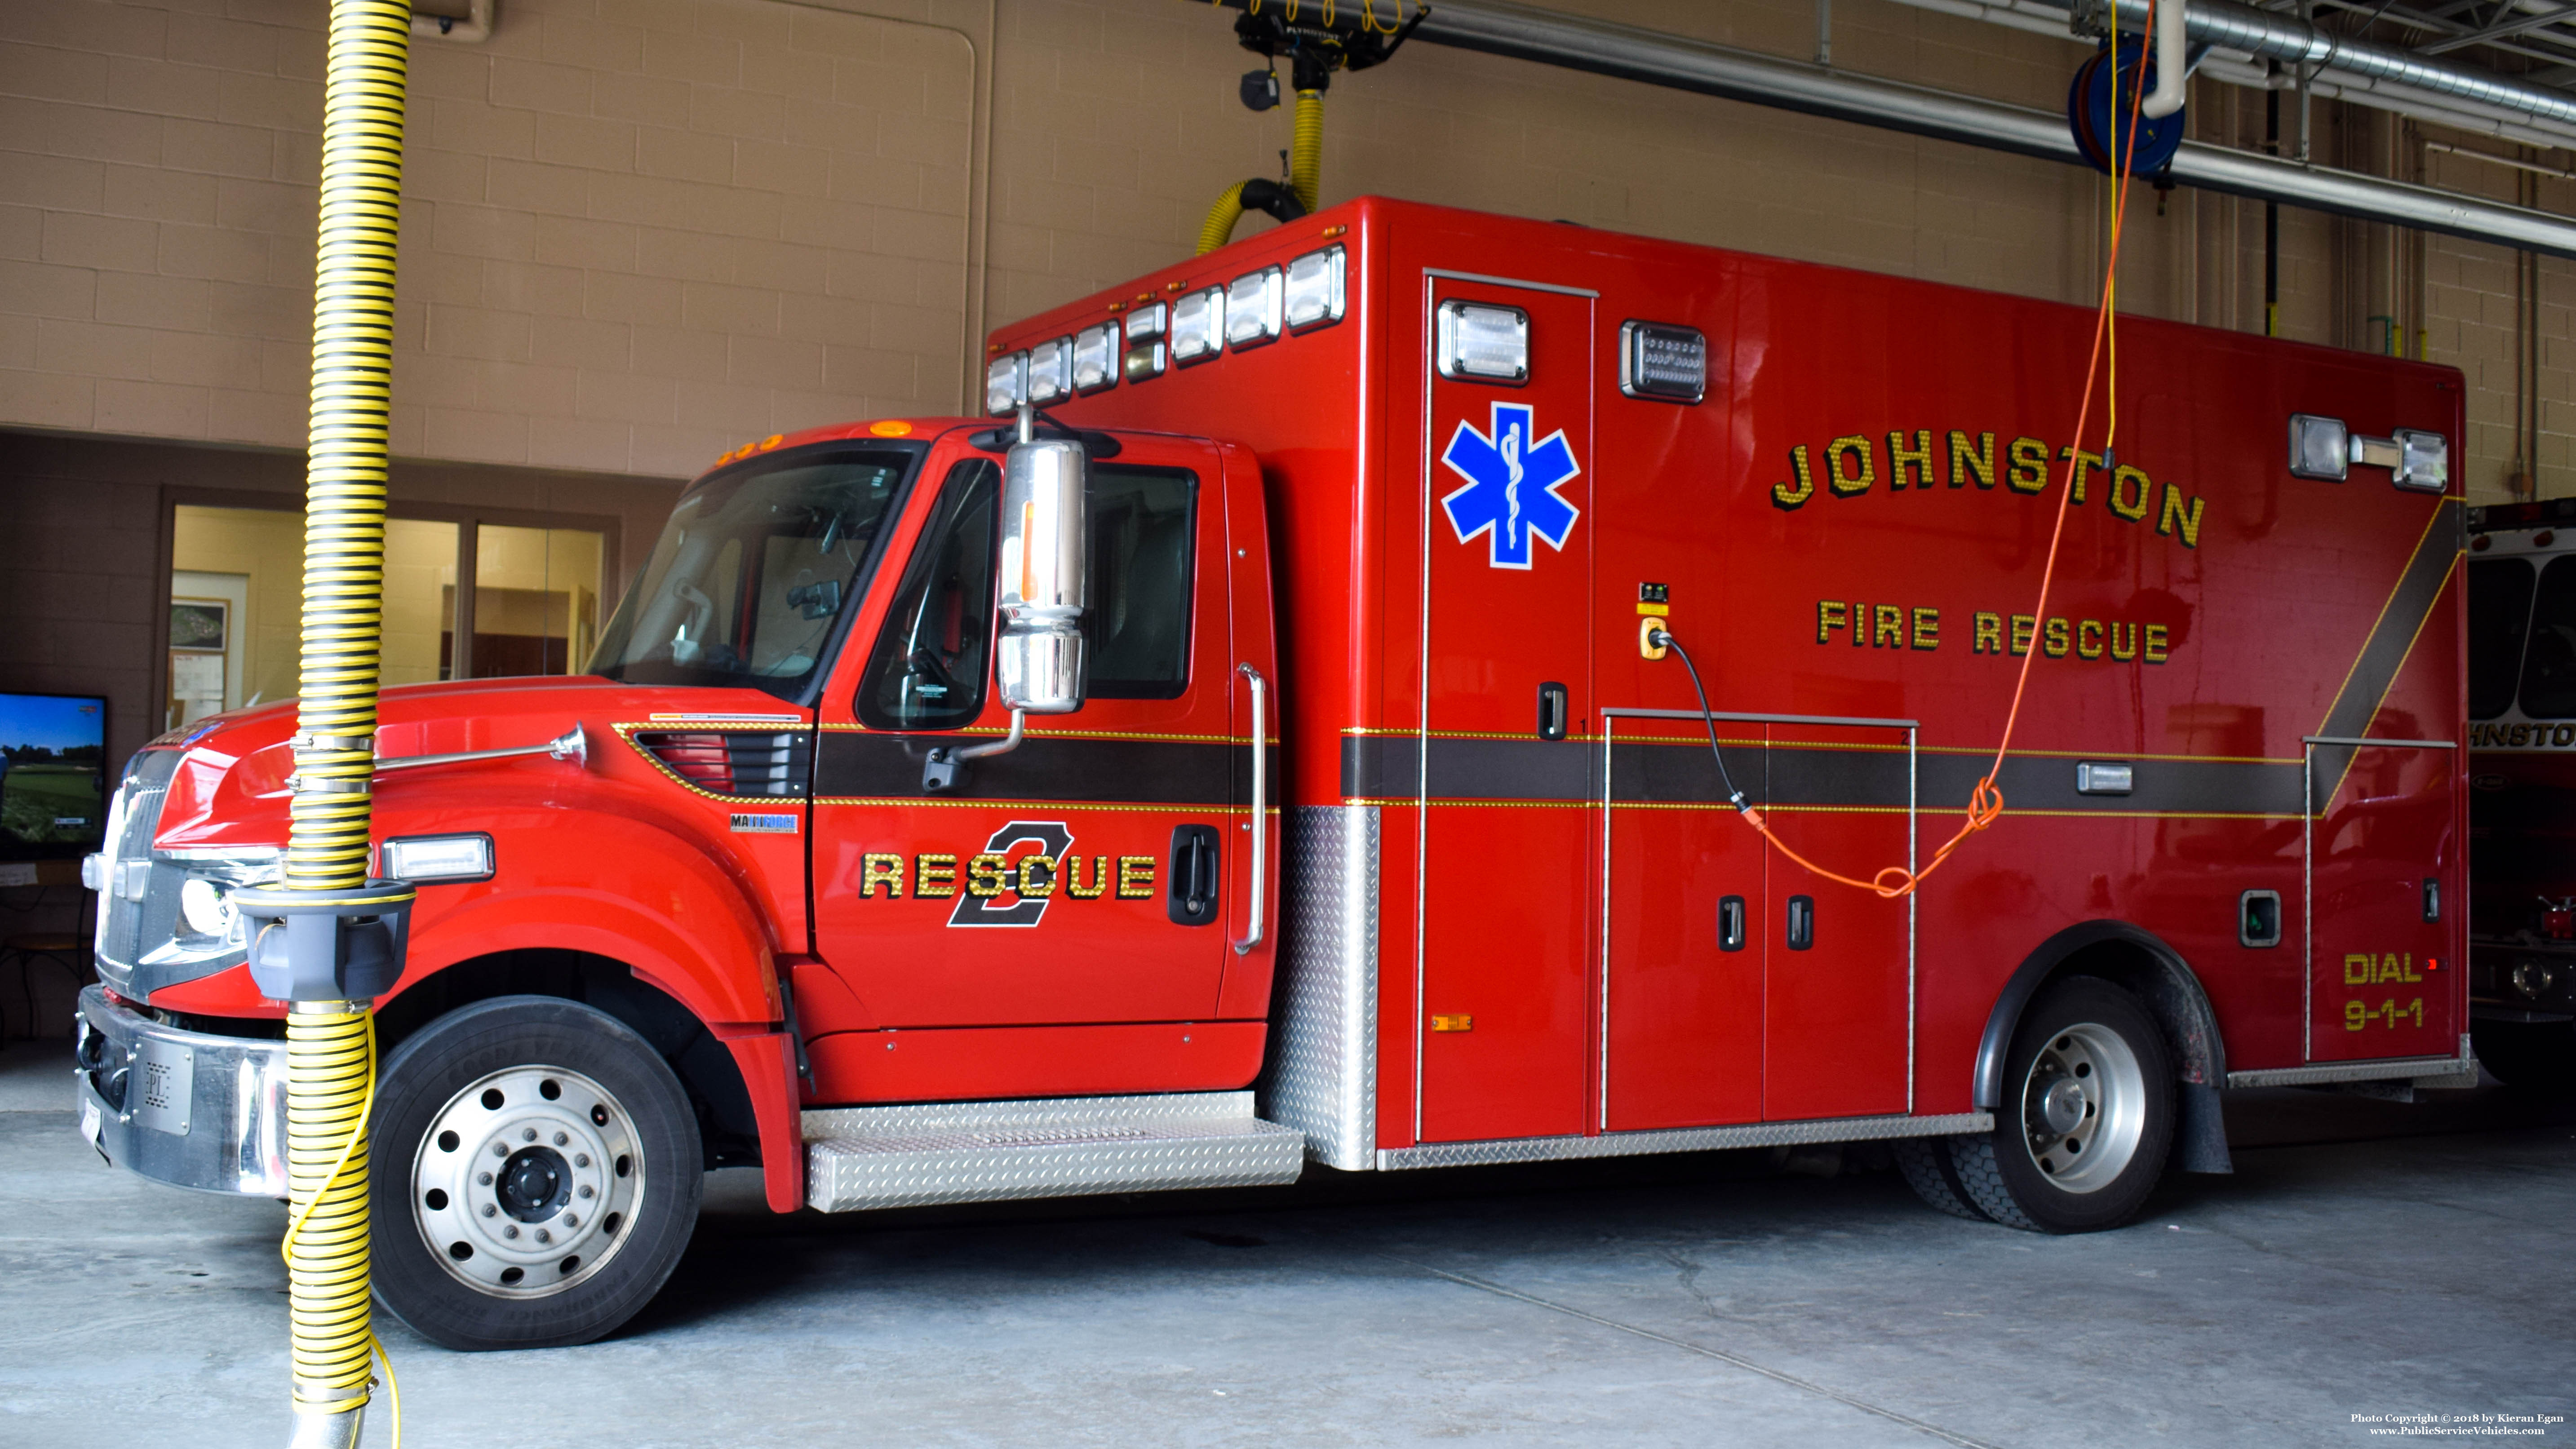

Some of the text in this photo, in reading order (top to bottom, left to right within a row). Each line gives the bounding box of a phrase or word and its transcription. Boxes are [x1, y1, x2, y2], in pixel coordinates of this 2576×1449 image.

[1770, 430, 2205, 549] JOHNSTON
[1817, 599, 2168, 665] FIRE RESCUE
[1901, 731, 1909, 745] 2
[859, 852, 1156, 900] RESCUE
[946, 820, 1075, 928] 2
[2345, 953, 2422, 985] DIAL
[2345, 997, 2423, 1032] 9-1-1
